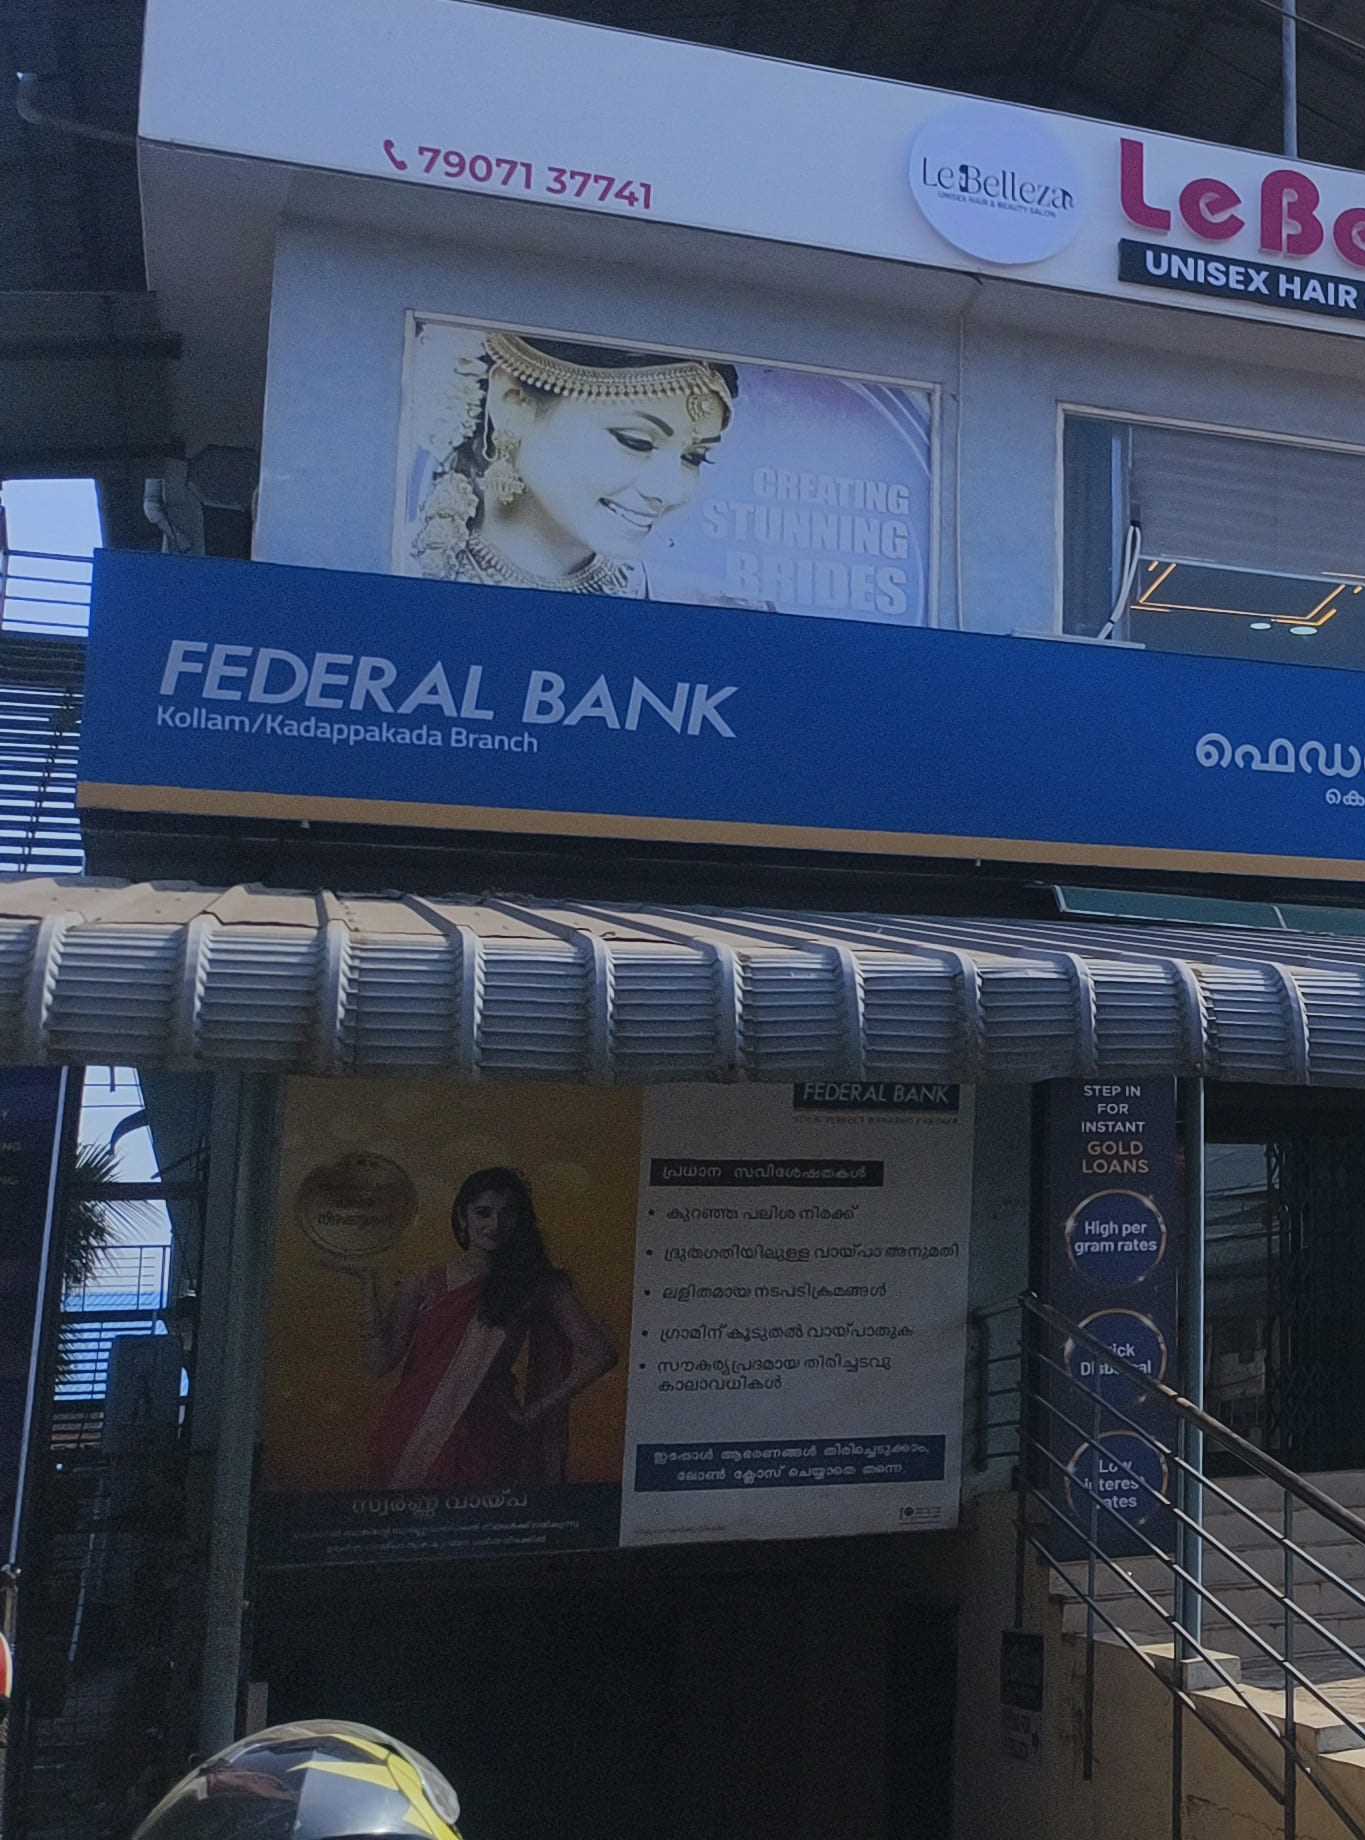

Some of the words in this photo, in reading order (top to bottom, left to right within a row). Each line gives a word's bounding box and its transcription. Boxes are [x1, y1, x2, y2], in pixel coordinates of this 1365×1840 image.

[418, 145, 534, 190] 79071
[545, 165, 653, 211] 37741
[1144, 249, 1270, 296] UNISEX
[1278, 273, 1358, 313] HAIR
[752, 465, 910, 515] CREATING
[703, 503, 908, 559] STUNNING
[725, 551, 907, 616] BRIDES
[160, 640, 495, 721] FEDERAL
[522, 670, 739, 738] BANK
[157, 705, 443, 749] Kollam/Kadappakada
[450, 729, 539, 753] Branch
[803, 1084, 887, 1102] FEDERAL
[893, 1086, 949, 1103] BANK
[1083, 1085, 1121, 1097] STEP
[1125, 1085, 1141, 1097] IN
[1097, 1104, 1129, 1114] FOR
[1081, 1121, 1145, 1133] INSTANT
[1087, 1141, 1143, 1155] GOLD
[1082, 1159, 1149, 1174] LOANS
[1084, 1221, 1118, 1237] High
[1122, 1222, 1147, 1236] per
[1075, 1240, 1114, 1256] gram
[1118, 1239, 1157, 1252] rates
